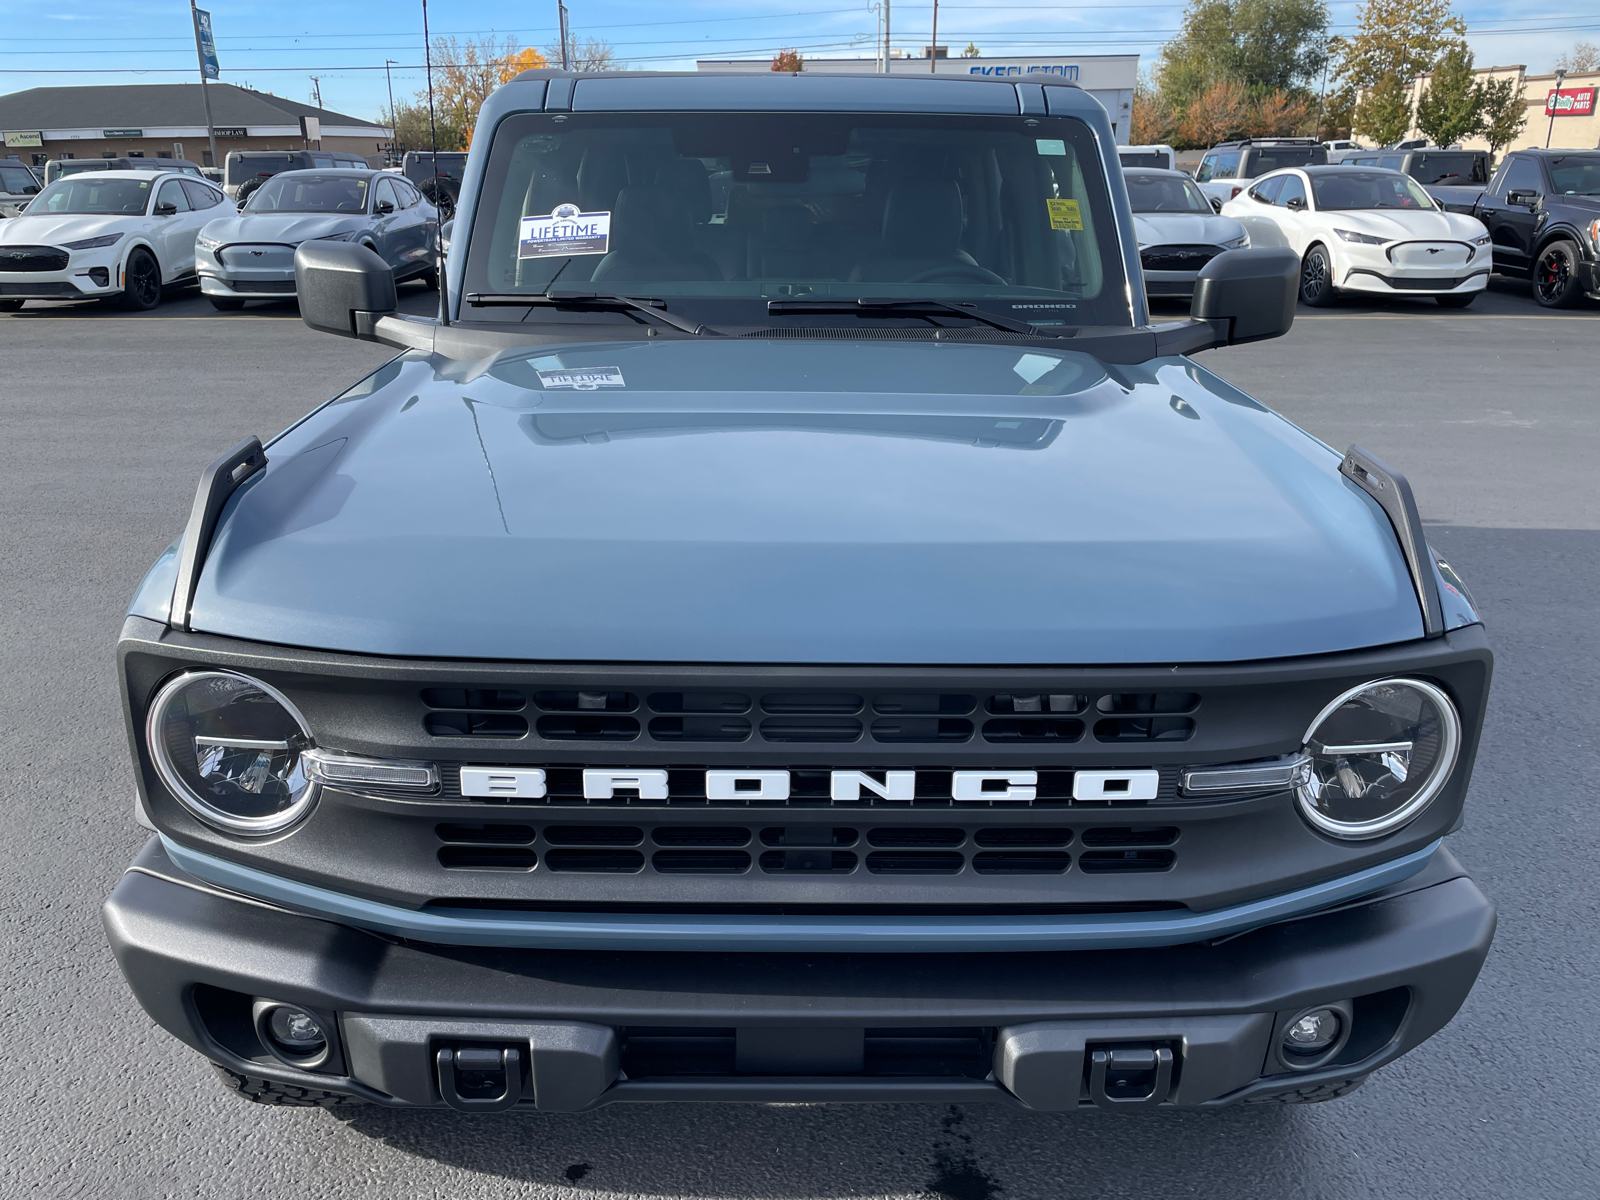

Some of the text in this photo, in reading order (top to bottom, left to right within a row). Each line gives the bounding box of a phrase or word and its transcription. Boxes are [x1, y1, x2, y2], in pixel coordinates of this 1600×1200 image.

[1549, 94, 1573, 109] OReilly
[1573, 101, 1590, 109] PARTS
[531, 224, 598, 240] LIFETIME
[460, 766, 1159, 801] BRONCO
